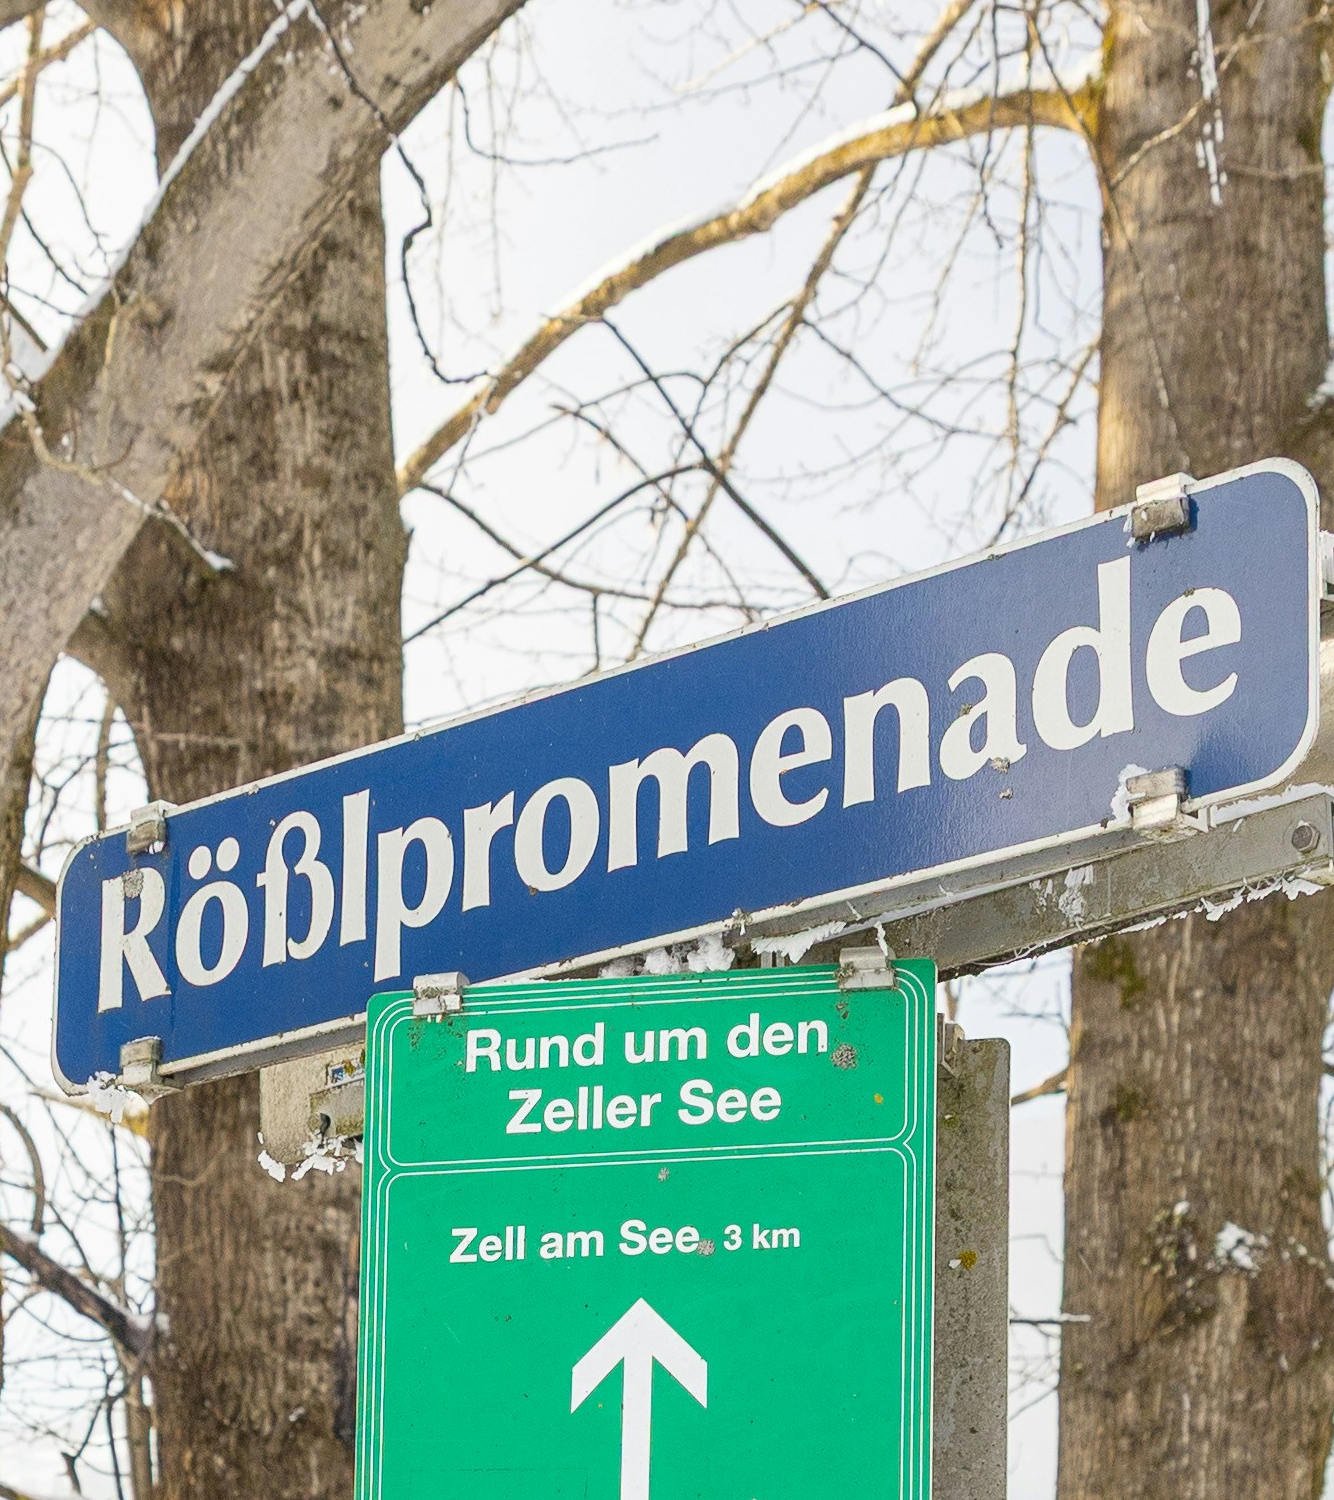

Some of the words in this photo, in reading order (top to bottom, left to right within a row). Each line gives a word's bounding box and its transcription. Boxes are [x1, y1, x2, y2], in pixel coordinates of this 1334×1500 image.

[98, 560, 1242, 1014] Rößlpromenade
[465, 1022, 605, 1073] Rund
[624, 1027, 707, 1064] um
[726, 1012, 829, 1058] den
[505, 1086, 662, 1134] Zeller
[678, 1078, 783, 1125] See
[449, 1225, 526, 1263] Zell
[539, 1230, 604, 1260] am
[723, 1224, 743, 1251] 3
[752, 1223, 801, 1250] km
